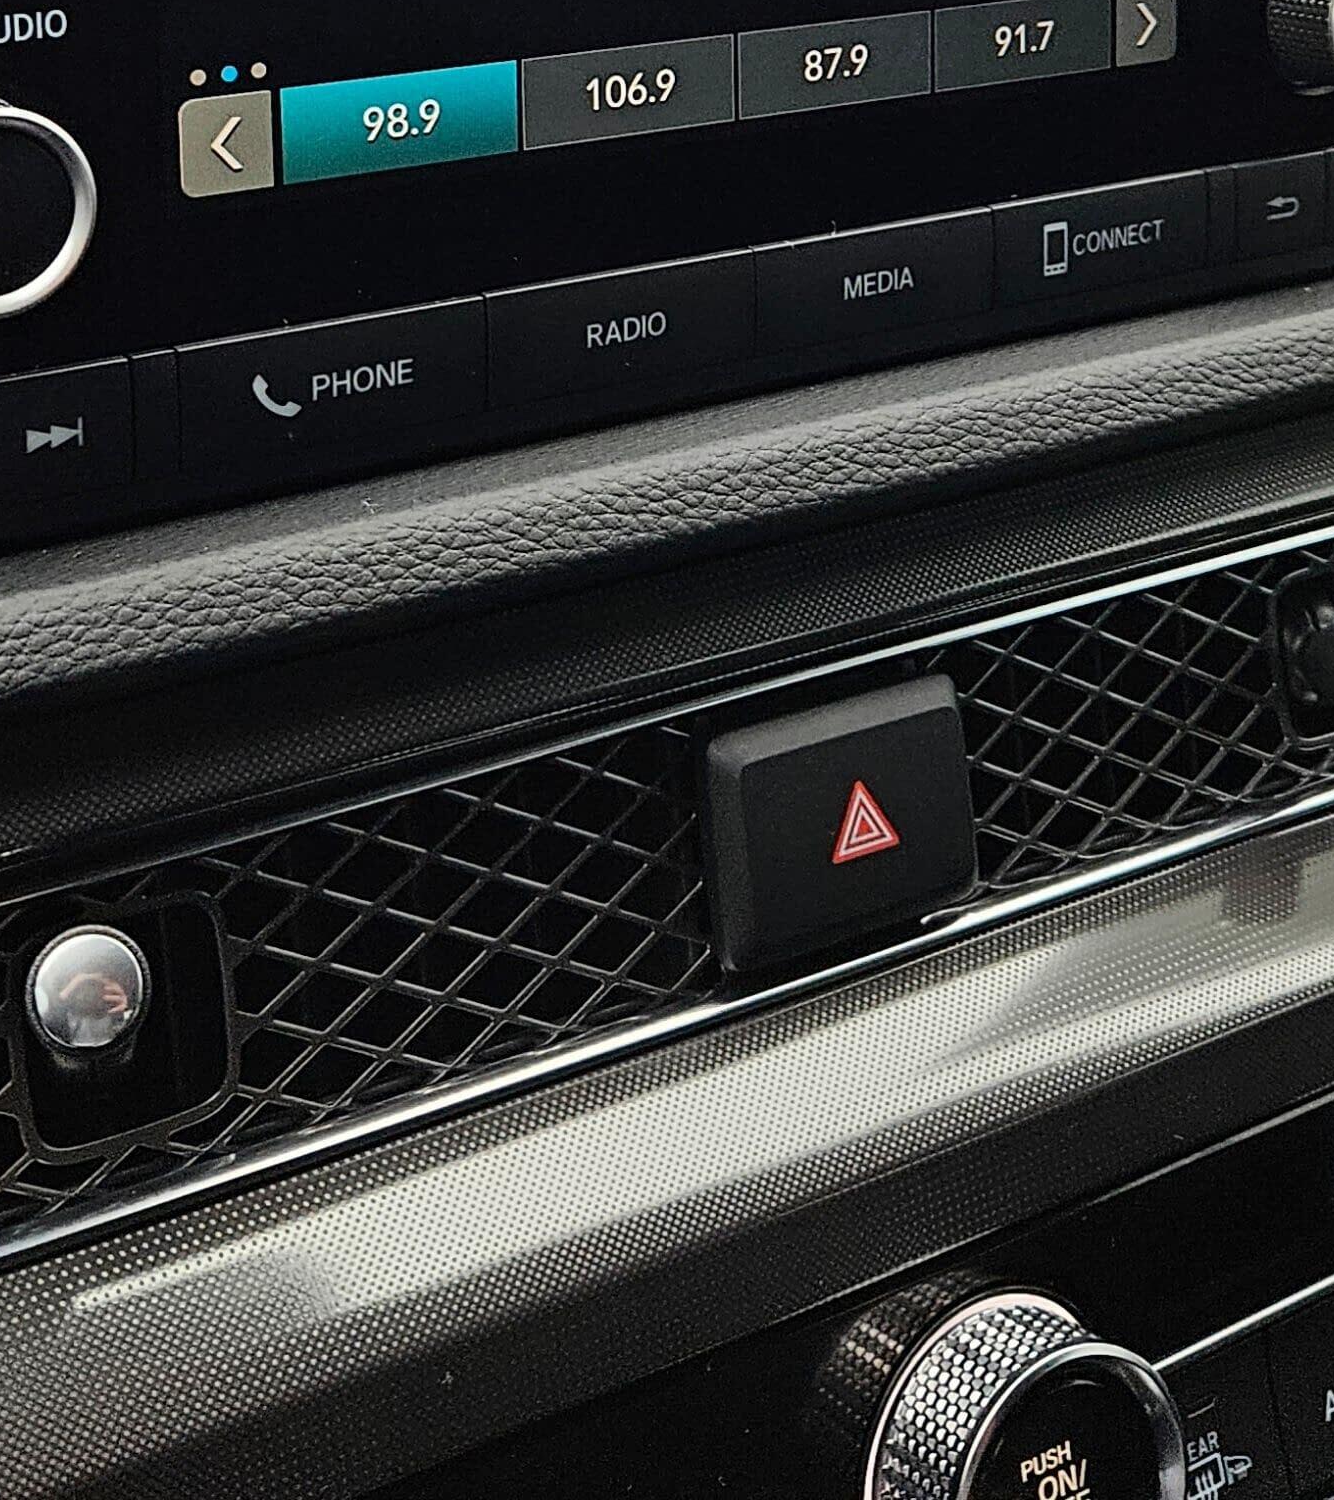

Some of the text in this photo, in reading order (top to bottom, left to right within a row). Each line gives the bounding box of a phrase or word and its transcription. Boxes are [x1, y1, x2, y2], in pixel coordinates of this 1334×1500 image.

[994, 20, 1056, 58] 91.7
[803, 43, 870, 83] 87.9
[585, 68, 678, 112] 106.9
[362, 98, 441, 142] 98.9
[1073, 219, 1165, 258] CONNECT
[843, 266, 915, 301] MEDIA
[586, 311, 668, 349] RADIO
[311, 358, 415, 401] PHONE
[1020, 1440, 1072, 1483] PUSH
[1187, 1430, 1220, 1463] EAR
